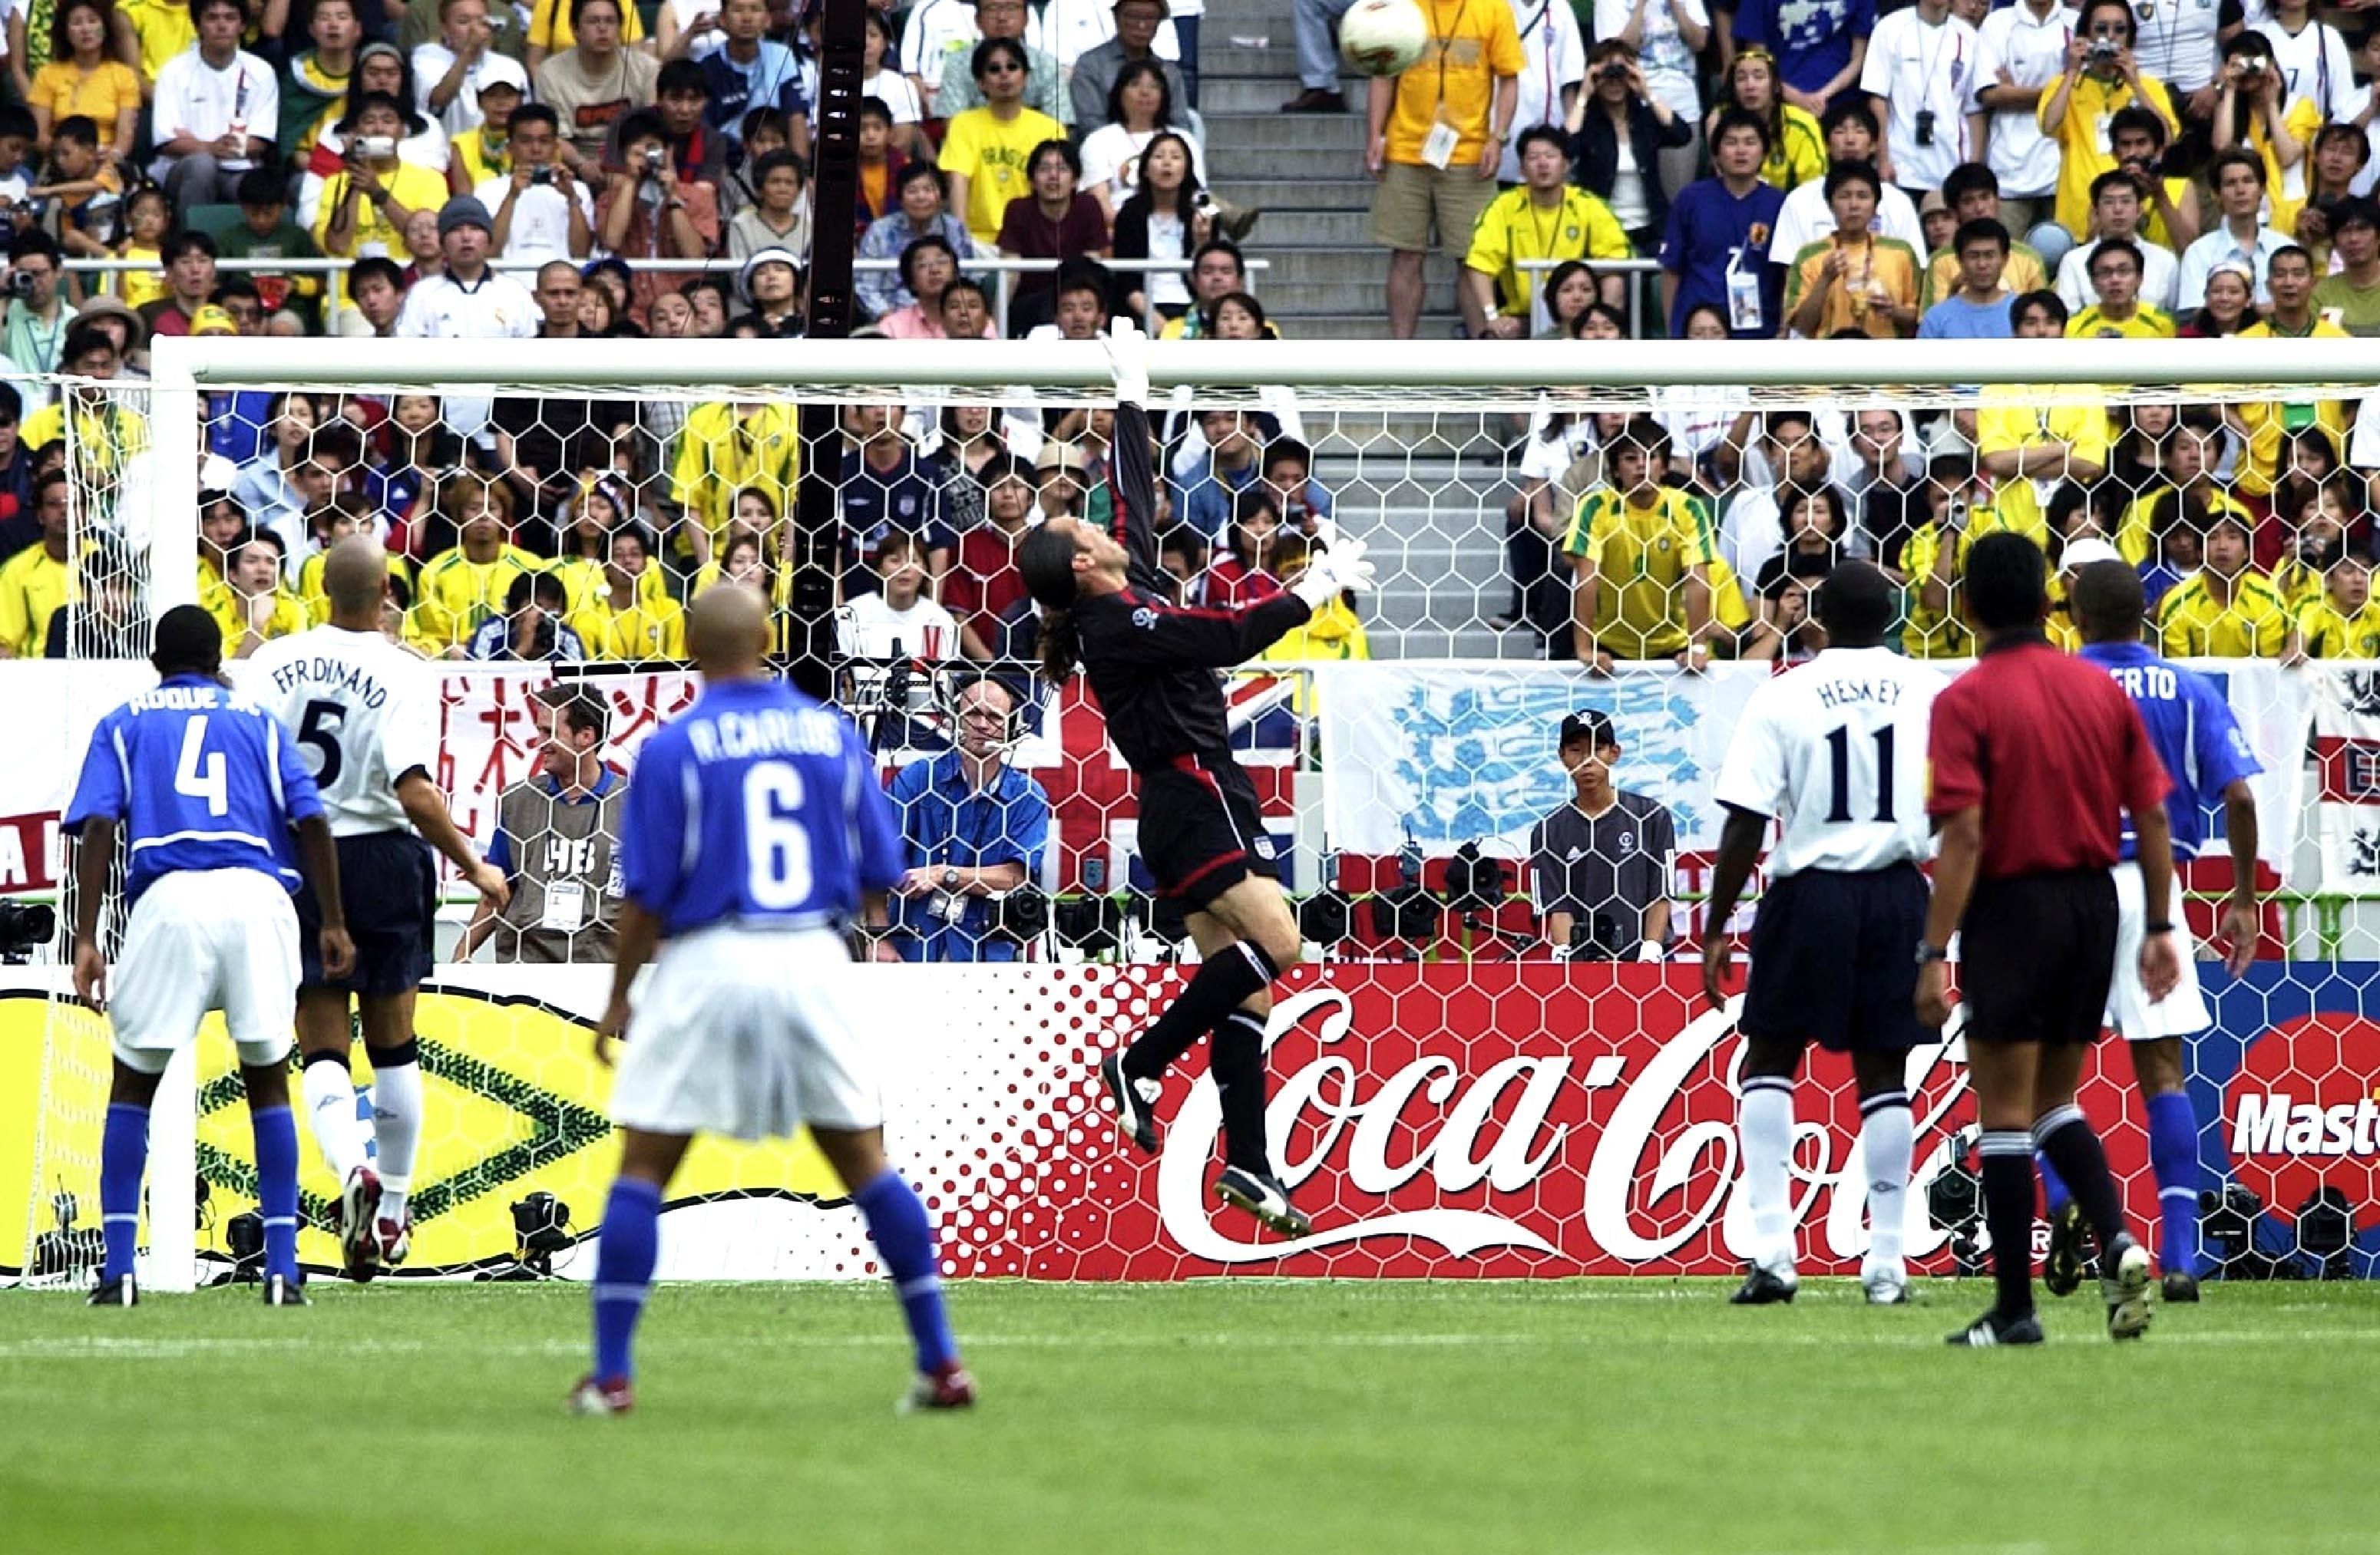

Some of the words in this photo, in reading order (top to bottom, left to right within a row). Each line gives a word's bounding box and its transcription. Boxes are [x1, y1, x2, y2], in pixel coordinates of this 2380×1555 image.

[129, 687, 219, 716] ROQUE
[1816, 678, 1905, 709] HESKEY
[174, 715, 228, 817] 4
[297, 699, 347, 789] 5
[1823, 723, 1898, 824] 11
[744, 759, 814, 910] 6
[2232, 1093, 2380, 1156] Mast
